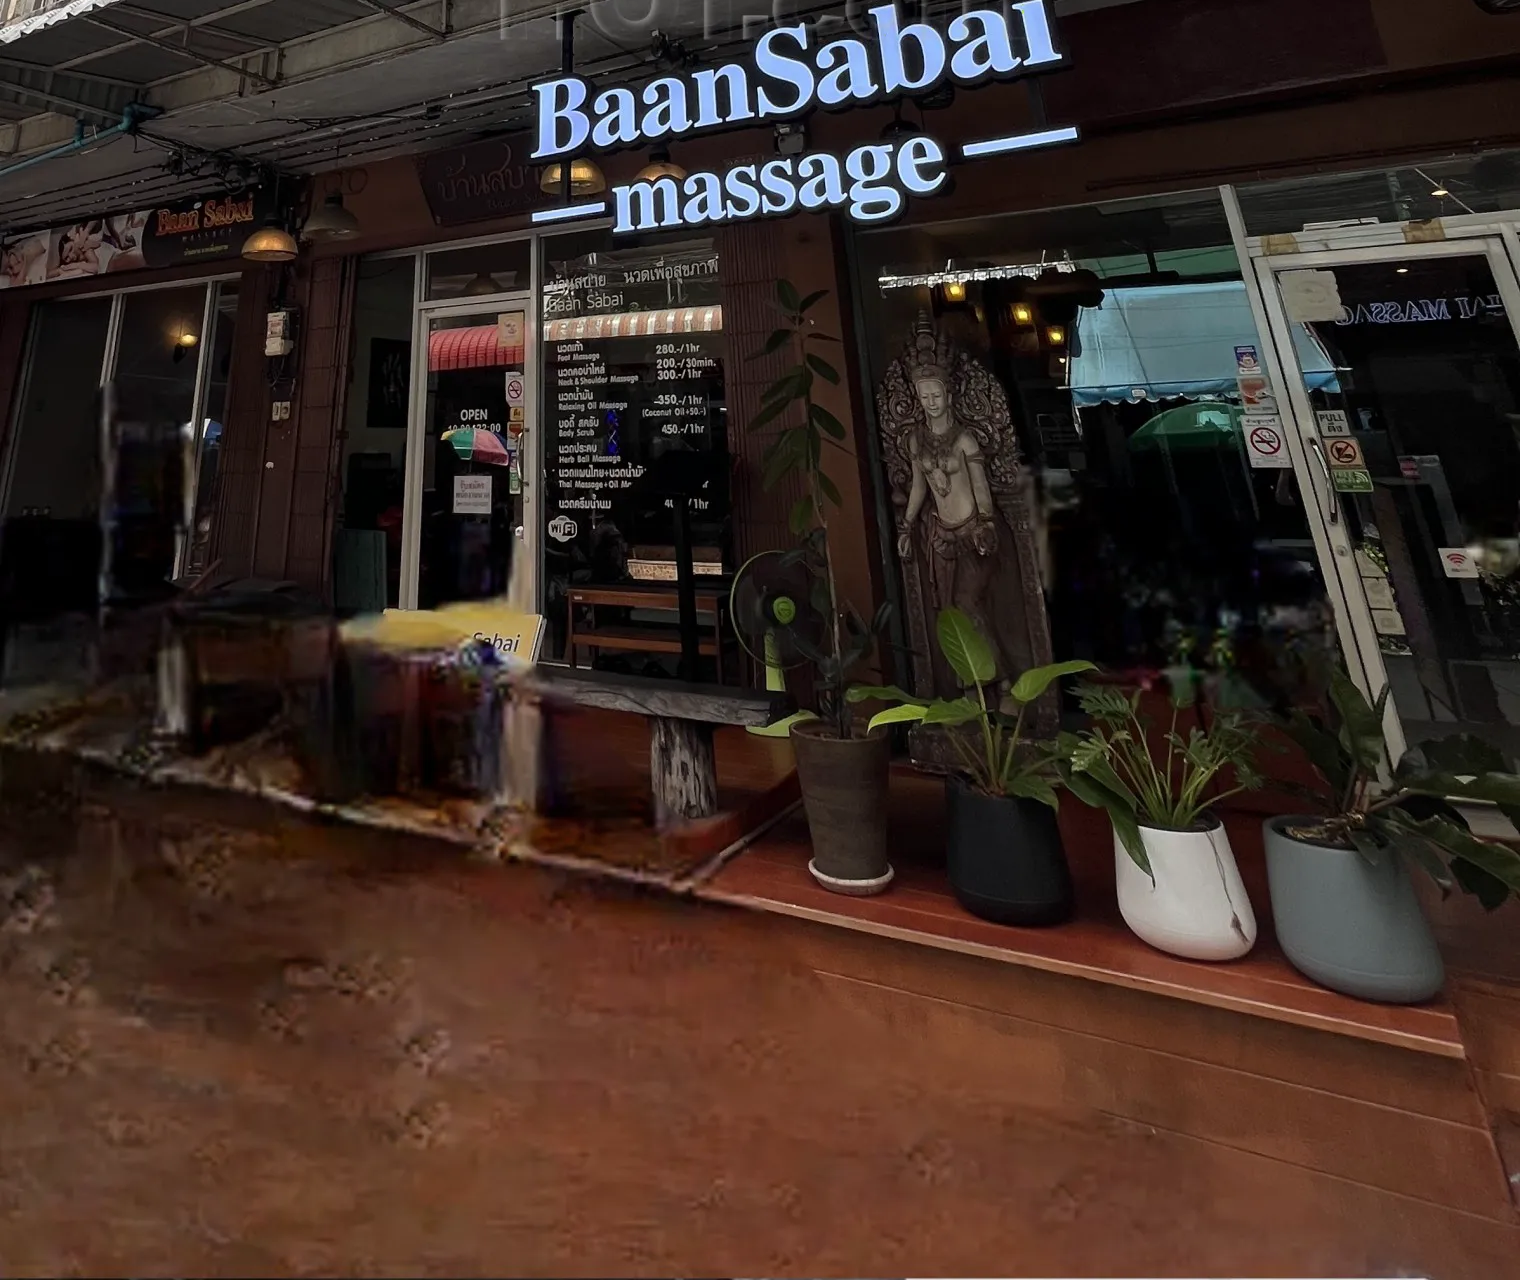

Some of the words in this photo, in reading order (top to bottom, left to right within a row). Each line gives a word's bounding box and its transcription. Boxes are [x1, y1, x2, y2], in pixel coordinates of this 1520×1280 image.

[437, 141, 543, 202] บ้านสบา
[612, 134, 946, 234] massage
[155, 208, 200, 238] Baan
[203, 191, 254, 229] Sabai
[587, 291, 624, 309] Sabai
[572, 353, 600, 363] Massage
[557, 378, 574, 387] Neck
[580, 376, 608, 385] Shoulder
[610, 374, 639, 385] Massage
[557, 386, 594, 402] นวดน้ำมัน
[558, 401, 585, 412] Relaxing
[587, 401, 597, 410] Oil
[598, 401, 628, 412] Massage
[642, 408, 672, 418] (Coconut
[460, 408, 488, 421] OPEN
[1319, 413, 1345, 423] PULL
[558, 429, 575, 438] Body
[576, 428, 595, 437] Scrub
[558, 456, 575, 464] Herb
[577, 455, 590, 464] Ball
[592, 455, 622, 465] Massage
[558, 480, 573, 489] Thai
[558, 493, 612, 510] นวดครีมน้ำนม
